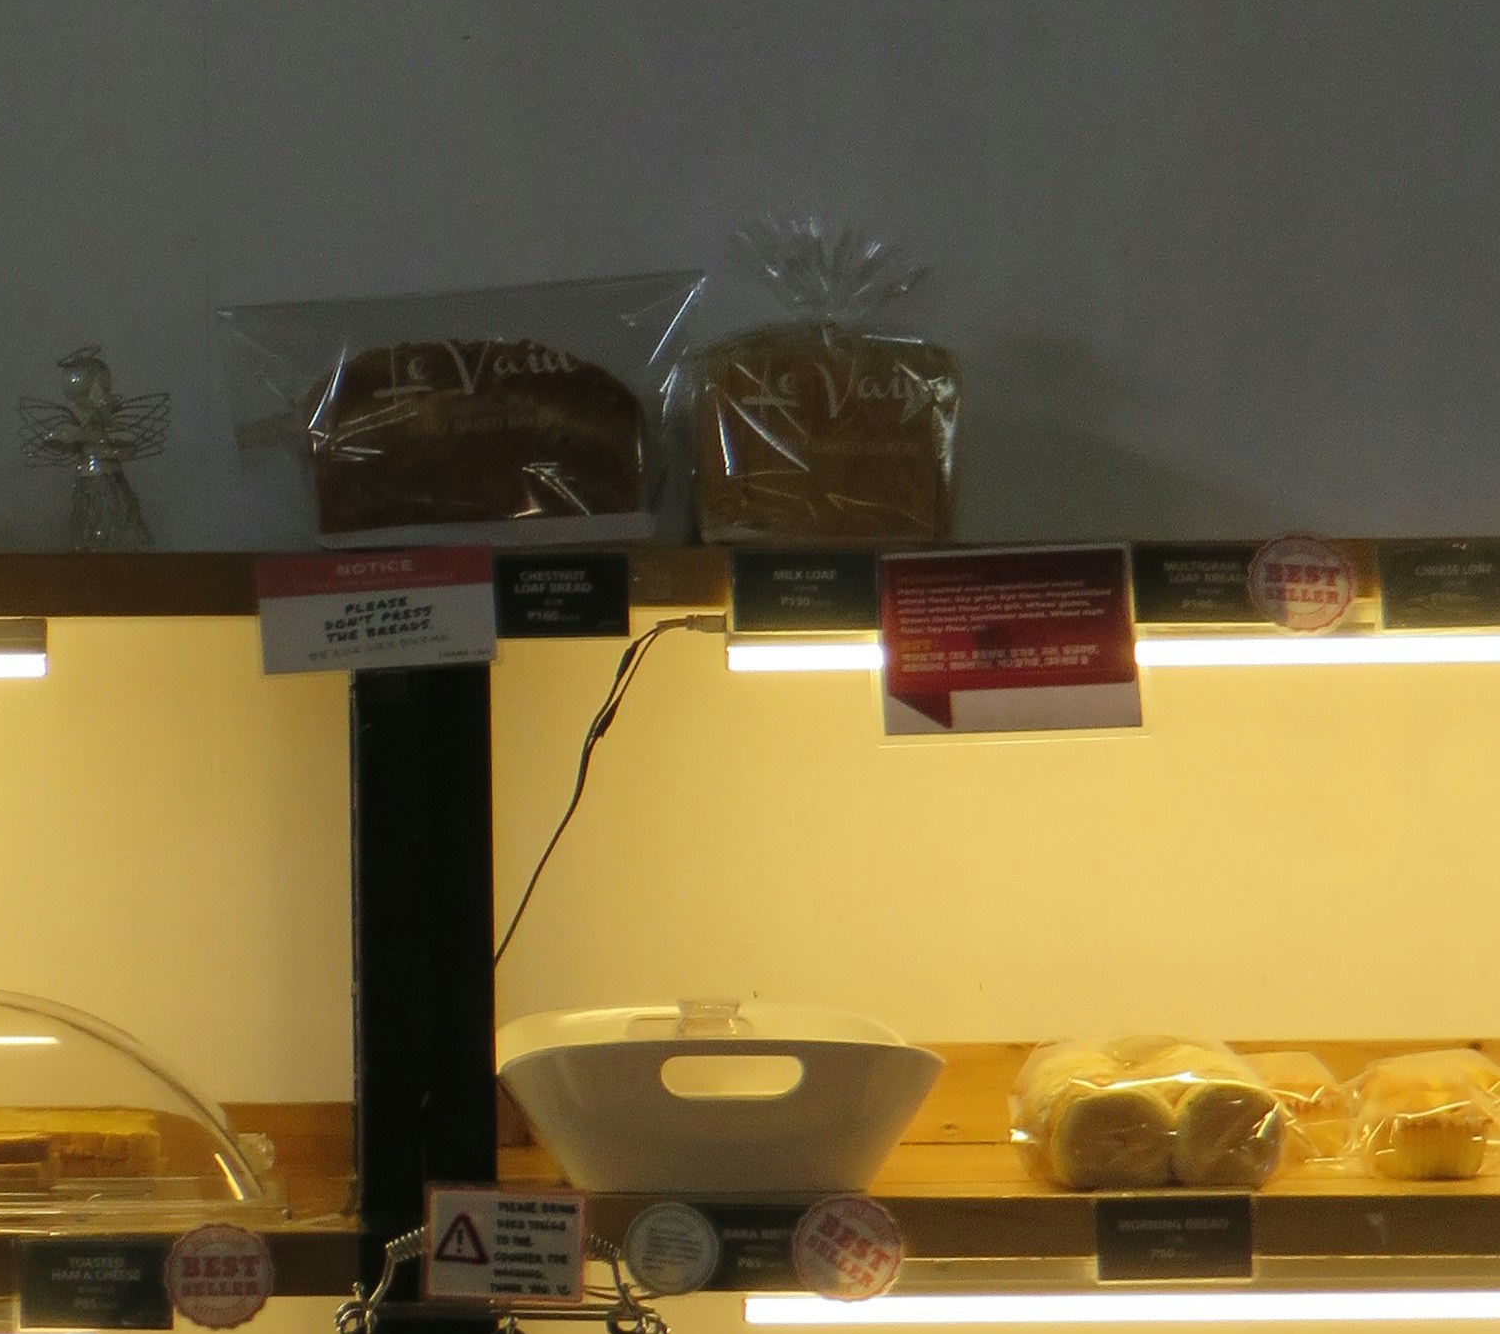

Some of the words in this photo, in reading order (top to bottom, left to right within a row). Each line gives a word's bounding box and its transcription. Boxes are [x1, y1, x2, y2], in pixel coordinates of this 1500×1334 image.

[336, 559, 414, 576] NOTICE
[773, 569, 803, 580] MILK
[805, 569, 837, 580] LOAF
[1263, 562, 1341, 584] BEST
[520, 570, 586, 582] CHESTNUT
[1169, 573, 1202, 583] LOAF
[514, 582, 546, 594] LOAF
[550, 582, 593, 594] BREAD
[1263, 588, 1340, 604] SELLER
[344, 596, 408, 614] PLEASE
[324, 613, 374, 631] DON'T
[380, 605, 433, 623] PRESS
[326, 629, 358, 643] THE
[498, 1202, 536, 1213] PLEASE
[1118, 1218, 1182, 1231] MORNING
[1184, 1218, 1230, 1230] BREAD
[818, 1212, 891, 1273] BEST
[69, 1257, 126, 1269] TOASTED
[180, 1256, 261, 1278] BEST
[806, 1234, 875, 1289] SELLER
[51, 1269, 81, 1281] HAM
[82, 1269, 93, 1281] &
[94, 1268, 142, 1281] CHEESE
[181, 1282, 260, 1297] SELLER
